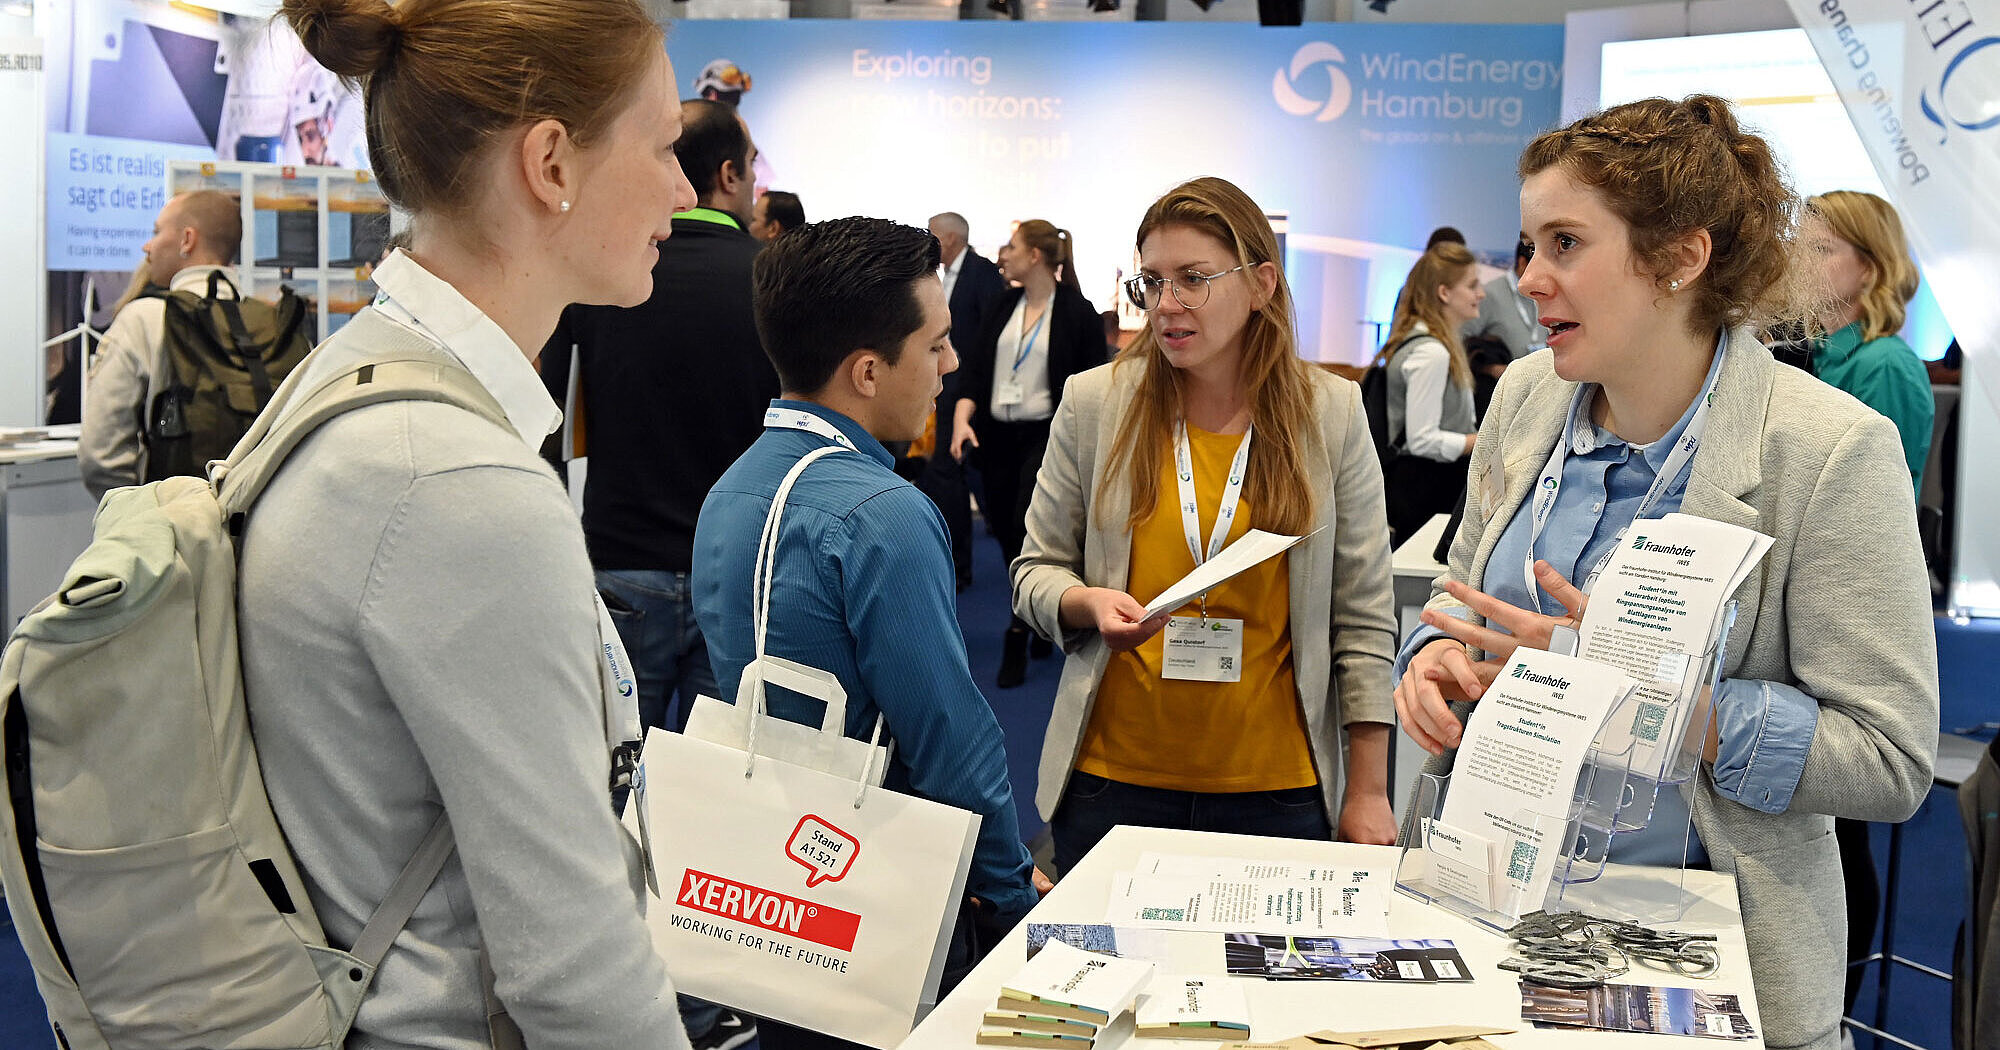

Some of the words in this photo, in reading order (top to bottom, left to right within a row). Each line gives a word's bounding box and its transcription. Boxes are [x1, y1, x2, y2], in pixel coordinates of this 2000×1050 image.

[853, 49, 992, 85] Exploring
[1361, 52, 1563, 90] WindEnergy
[928, 90, 1063, 120] horizons:
[1361, 89, 1522, 127] Hamburg
[69, 148, 87, 172] Es
[92, 151, 112, 174] ist
[68, 185, 105, 212] sagt
[111, 184, 136, 208] die
[1683, 435, 1696, 452] wpd
[1644, 540, 1696, 558] Fraunhofer
[1676, 559, 1690, 567] IWES
[1615, 597, 1674, 615] Ringspannungsanalyse
[1624, 589, 1657, 602] Masterarbeit
[1658, 596, 1684, 608] (optional)
[1617, 615, 1671, 633] Windenergieanlagen
[1627, 608, 1656, 620] Blattlagern
[1657, 614, 1667, 622] von
[1522, 671, 1571, 690] Fraunhofer
[1551, 691, 1564, 700] IWES
[1496, 720, 1532, 737] Tragstrukturen
[1533, 730, 1561, 745] Simulation
[812, 830, 843, 853] Stand
[799, 843, 837, 868] A1.521
[670, 914, 733, 942] WORKING
[738, 933, 764, 950] FOR
[769, 941, 792, 958] THE
[797, 949, 849, 974] FUTURE
